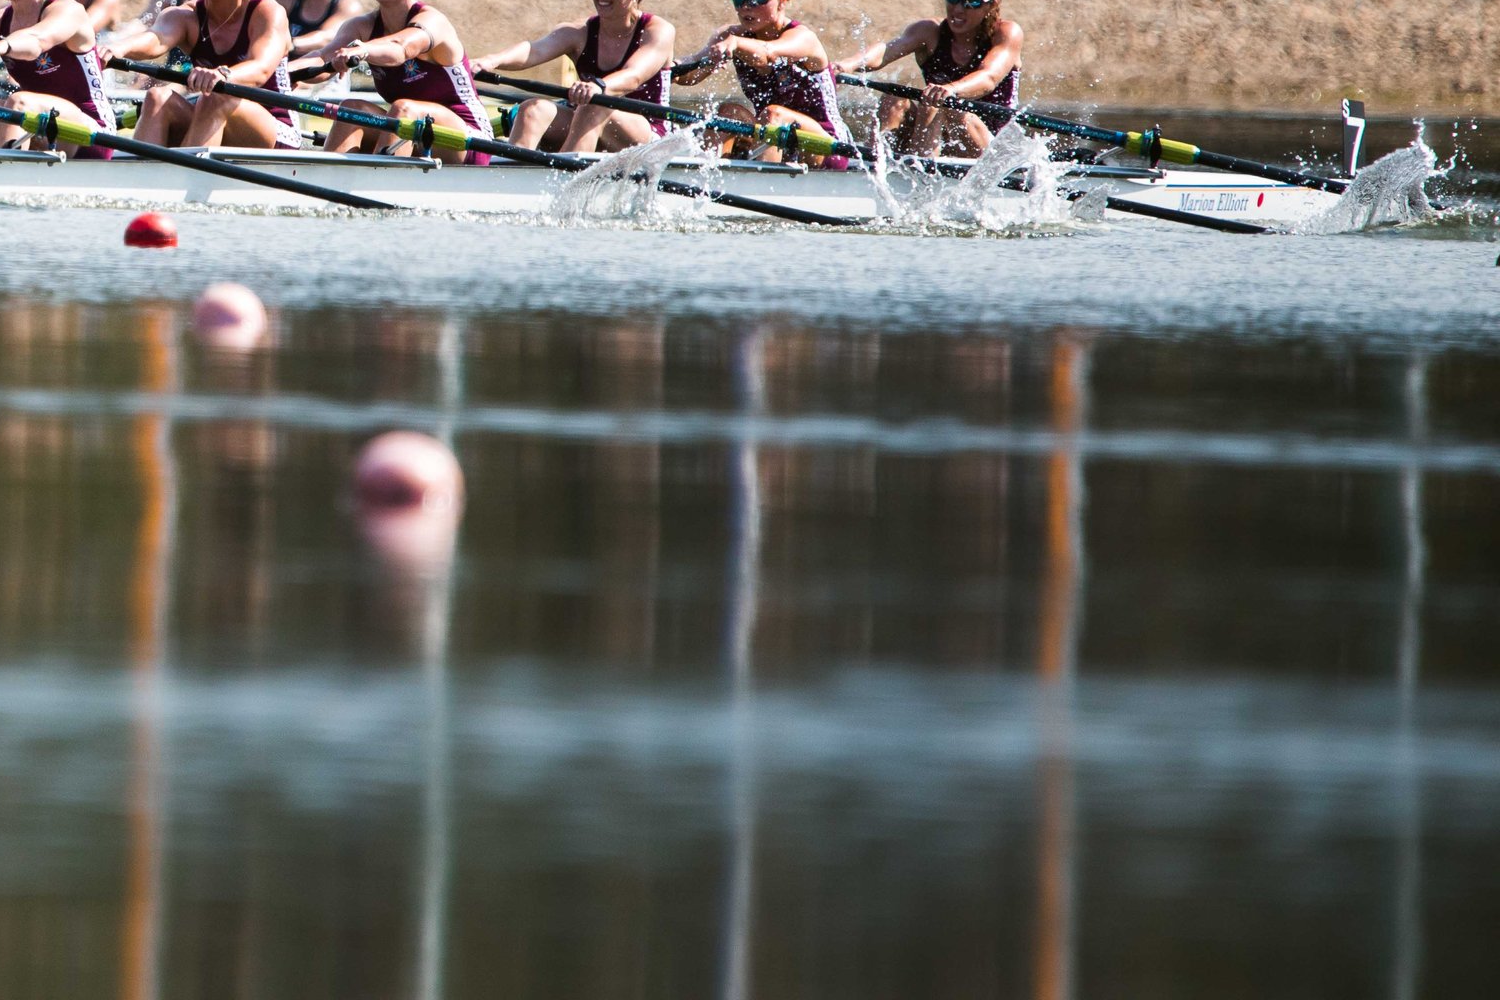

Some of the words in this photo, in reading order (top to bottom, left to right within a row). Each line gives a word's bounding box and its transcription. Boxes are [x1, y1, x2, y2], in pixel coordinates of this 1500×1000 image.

[1342, 98, 1350, 118] S
[352, 114, 386, 126] SKINNY
[1346, 116, 1366, 176] 7
[1178, 193, 1215, 211] Marion
[1217, 193, 1249, 211] Elliott
